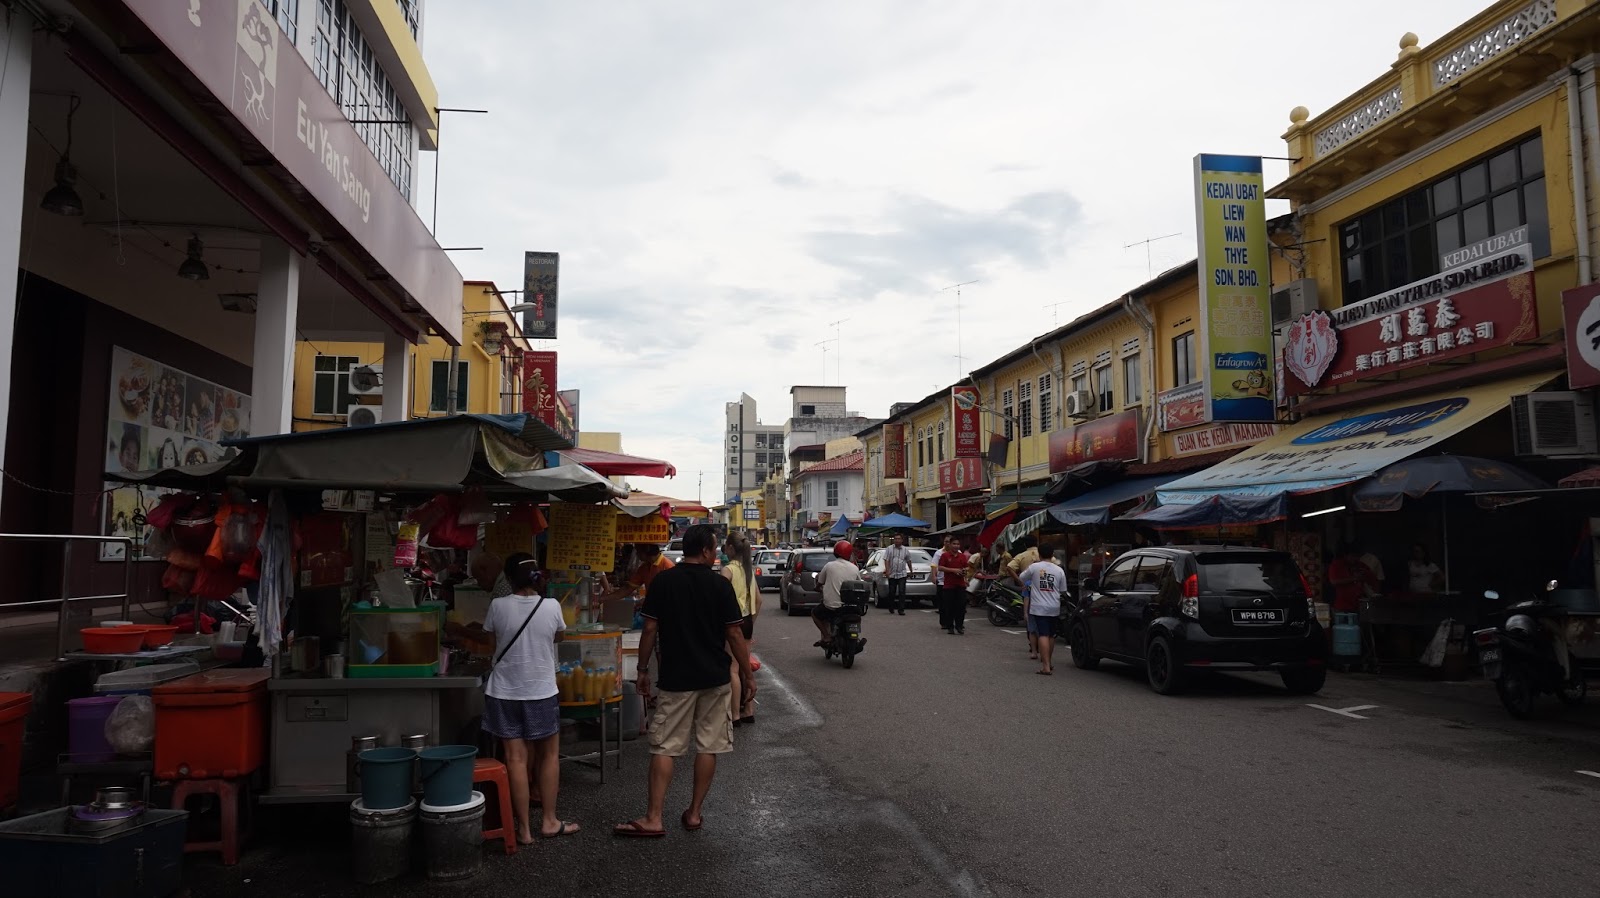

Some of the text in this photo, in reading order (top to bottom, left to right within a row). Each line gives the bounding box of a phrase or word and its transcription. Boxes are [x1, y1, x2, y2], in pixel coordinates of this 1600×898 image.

[297, 97, 371, 223] Eu Yan Sang
[1206, 182, 1258, 201] KEDAI UBAT
[1223, 204, 1245, 221] LIEW
[1224, 225, 1246, 243] WAN
[1224, 247, 1248, 265] THYE
[1443, 228, 1526, 269] KEDAI UBAT
[1215, 269, 1259, 287] SDN. BHD.
[1336, 302, 1367, 325] LIEW
[1370, 293, 1400, 314] WAN
[1400, 278, 1443, 302] THYE
[1216, 354, 1255, 369] Enfagrow
[1331, 373, 1343, 381] Since
[1177, 424, 1274, 451] GUAN KEE KEDAI MAKANAN
[730, 423, 738, 475] HOTEL
[1240, 611, 1275, 619] WPW 8718
